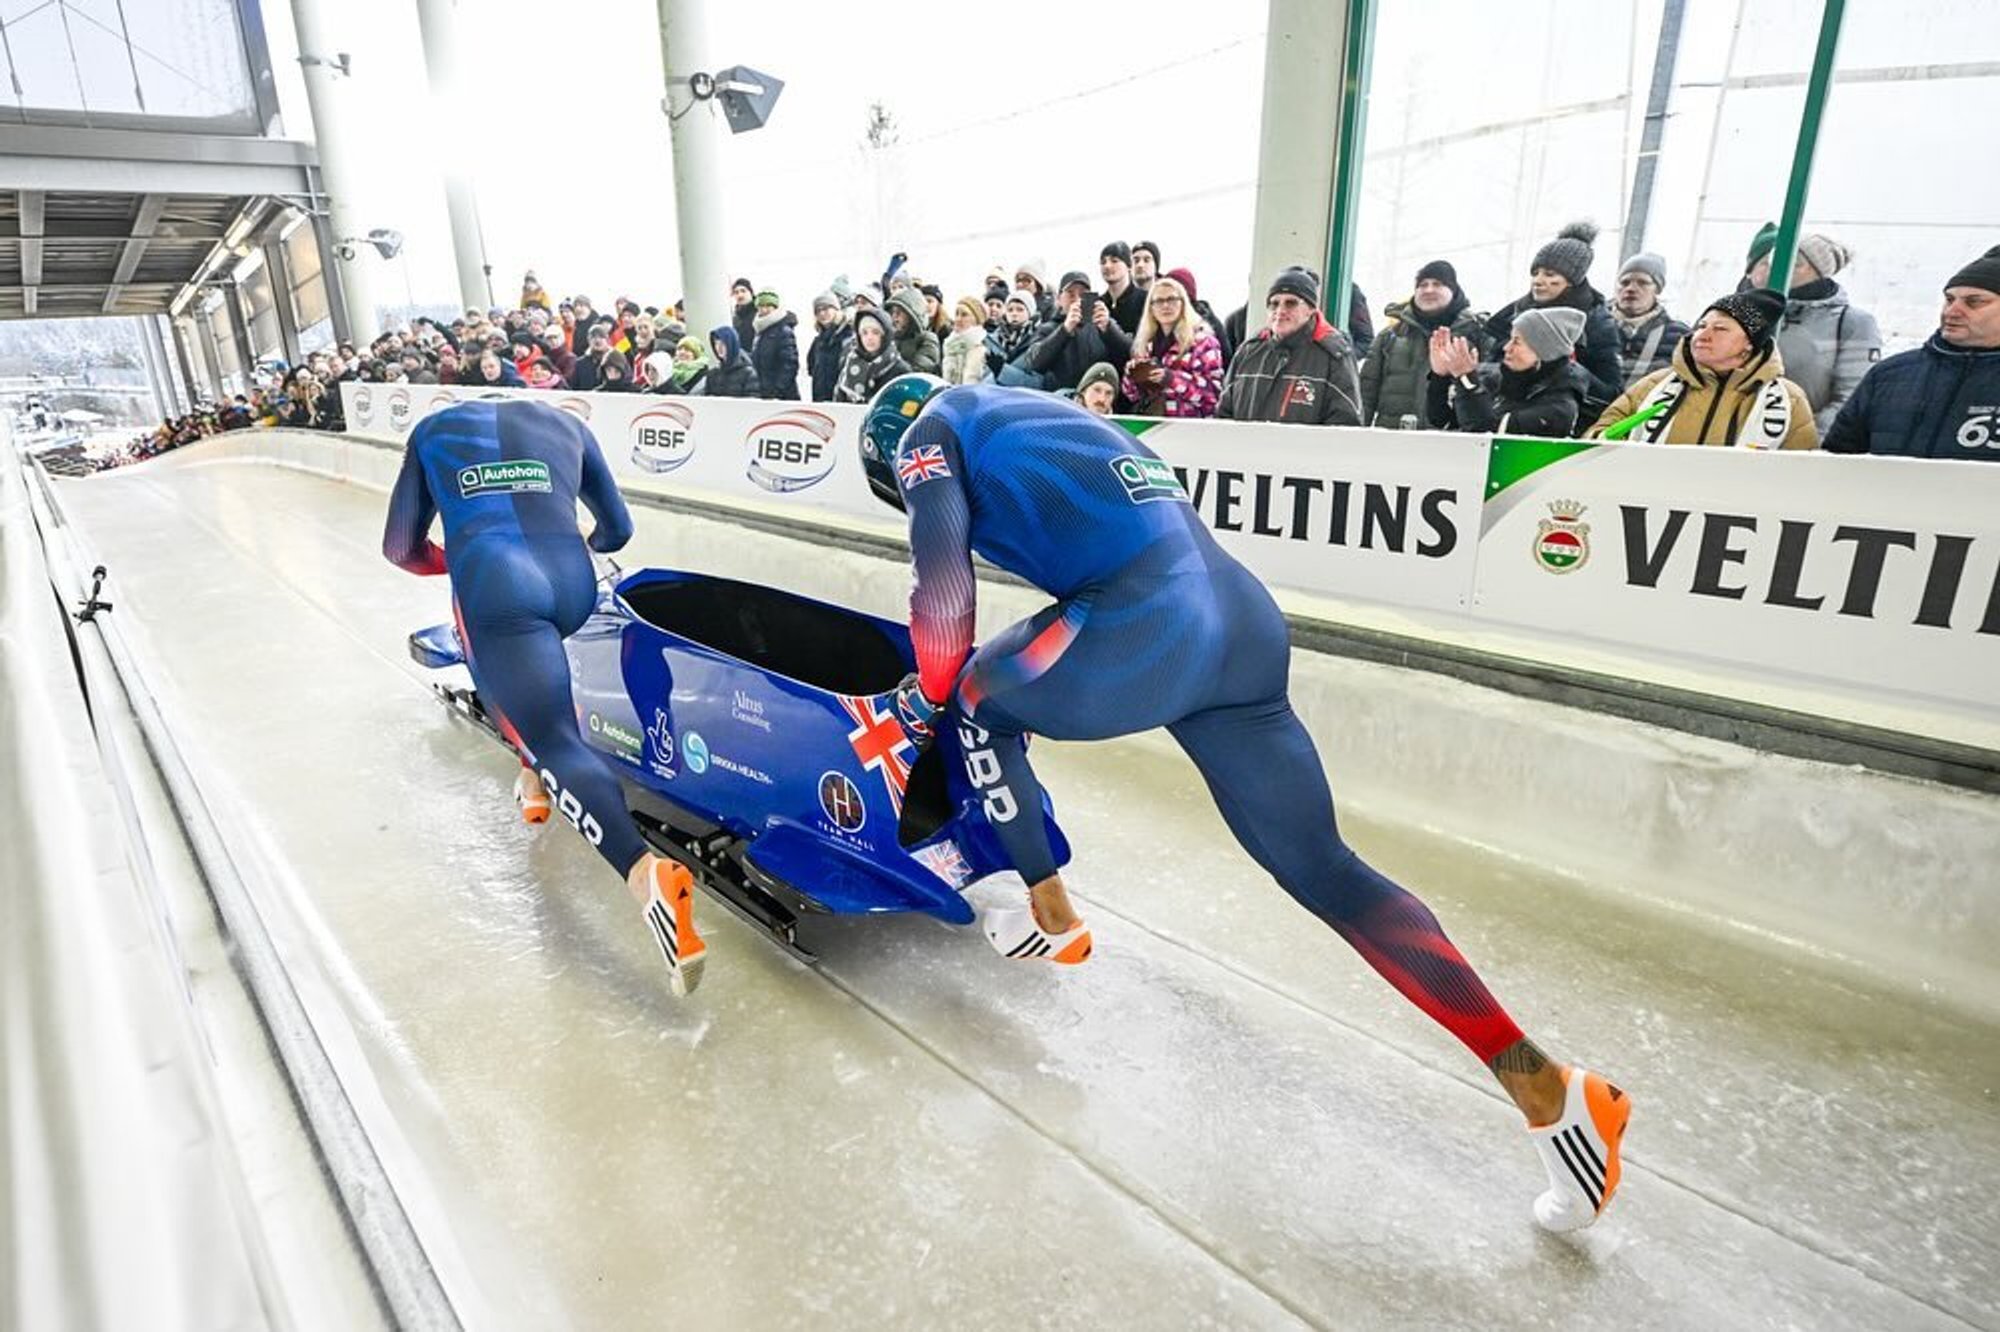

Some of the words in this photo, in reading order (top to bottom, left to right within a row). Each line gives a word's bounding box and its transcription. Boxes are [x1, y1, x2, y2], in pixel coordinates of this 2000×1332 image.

[638, 427, 685, 448] IBSF
[758, 438, 823, 465] IBSF
[484, 465, 547, 481] Autohorn
[1172, 466, 1458, 558] VELTINS
[1619, 504, 2000, 636] VELTI
[818, 820, 843, 837] TEAM
[849, 834, 875, 852] HALL
